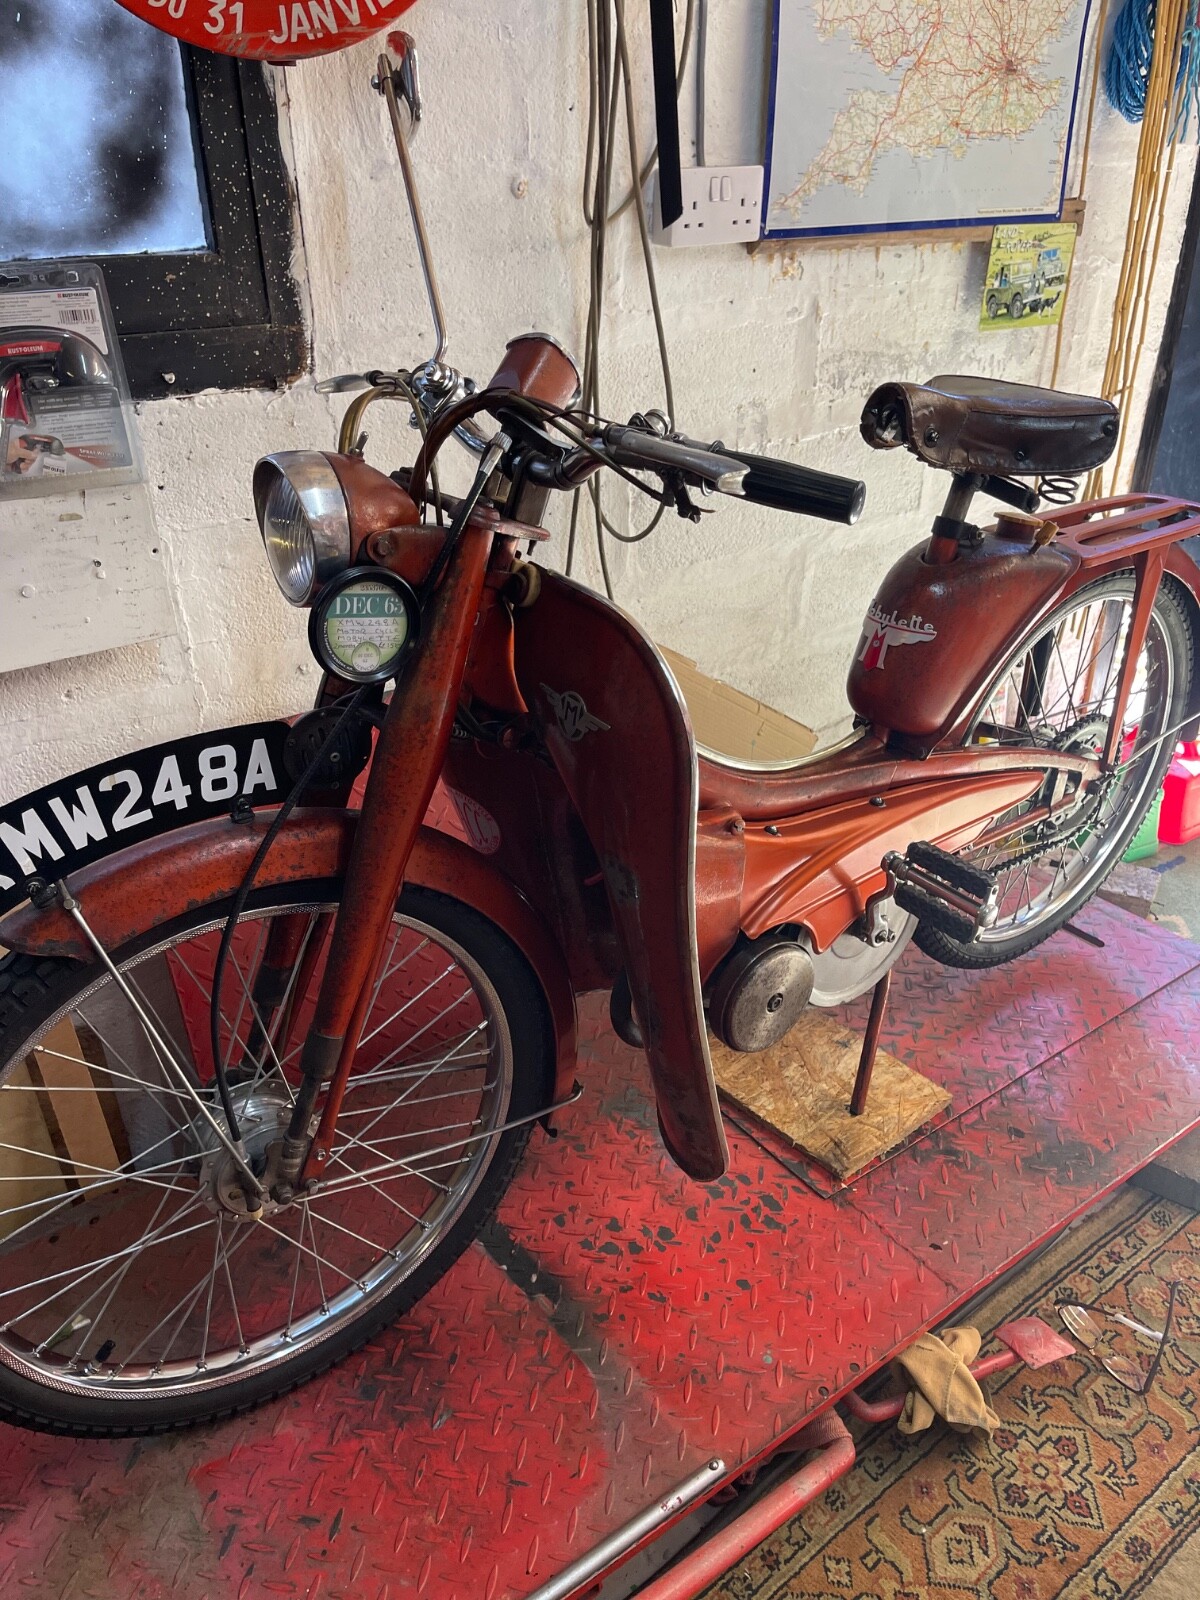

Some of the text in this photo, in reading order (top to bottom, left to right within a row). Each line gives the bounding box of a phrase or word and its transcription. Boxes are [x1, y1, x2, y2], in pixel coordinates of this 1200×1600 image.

[147, 0, 393, 44] U 31 JANV
[336, 597, 379, 615] DEC
[865, 598, 936, 634] obylette
[0, 738, 278, 891] MW248A
